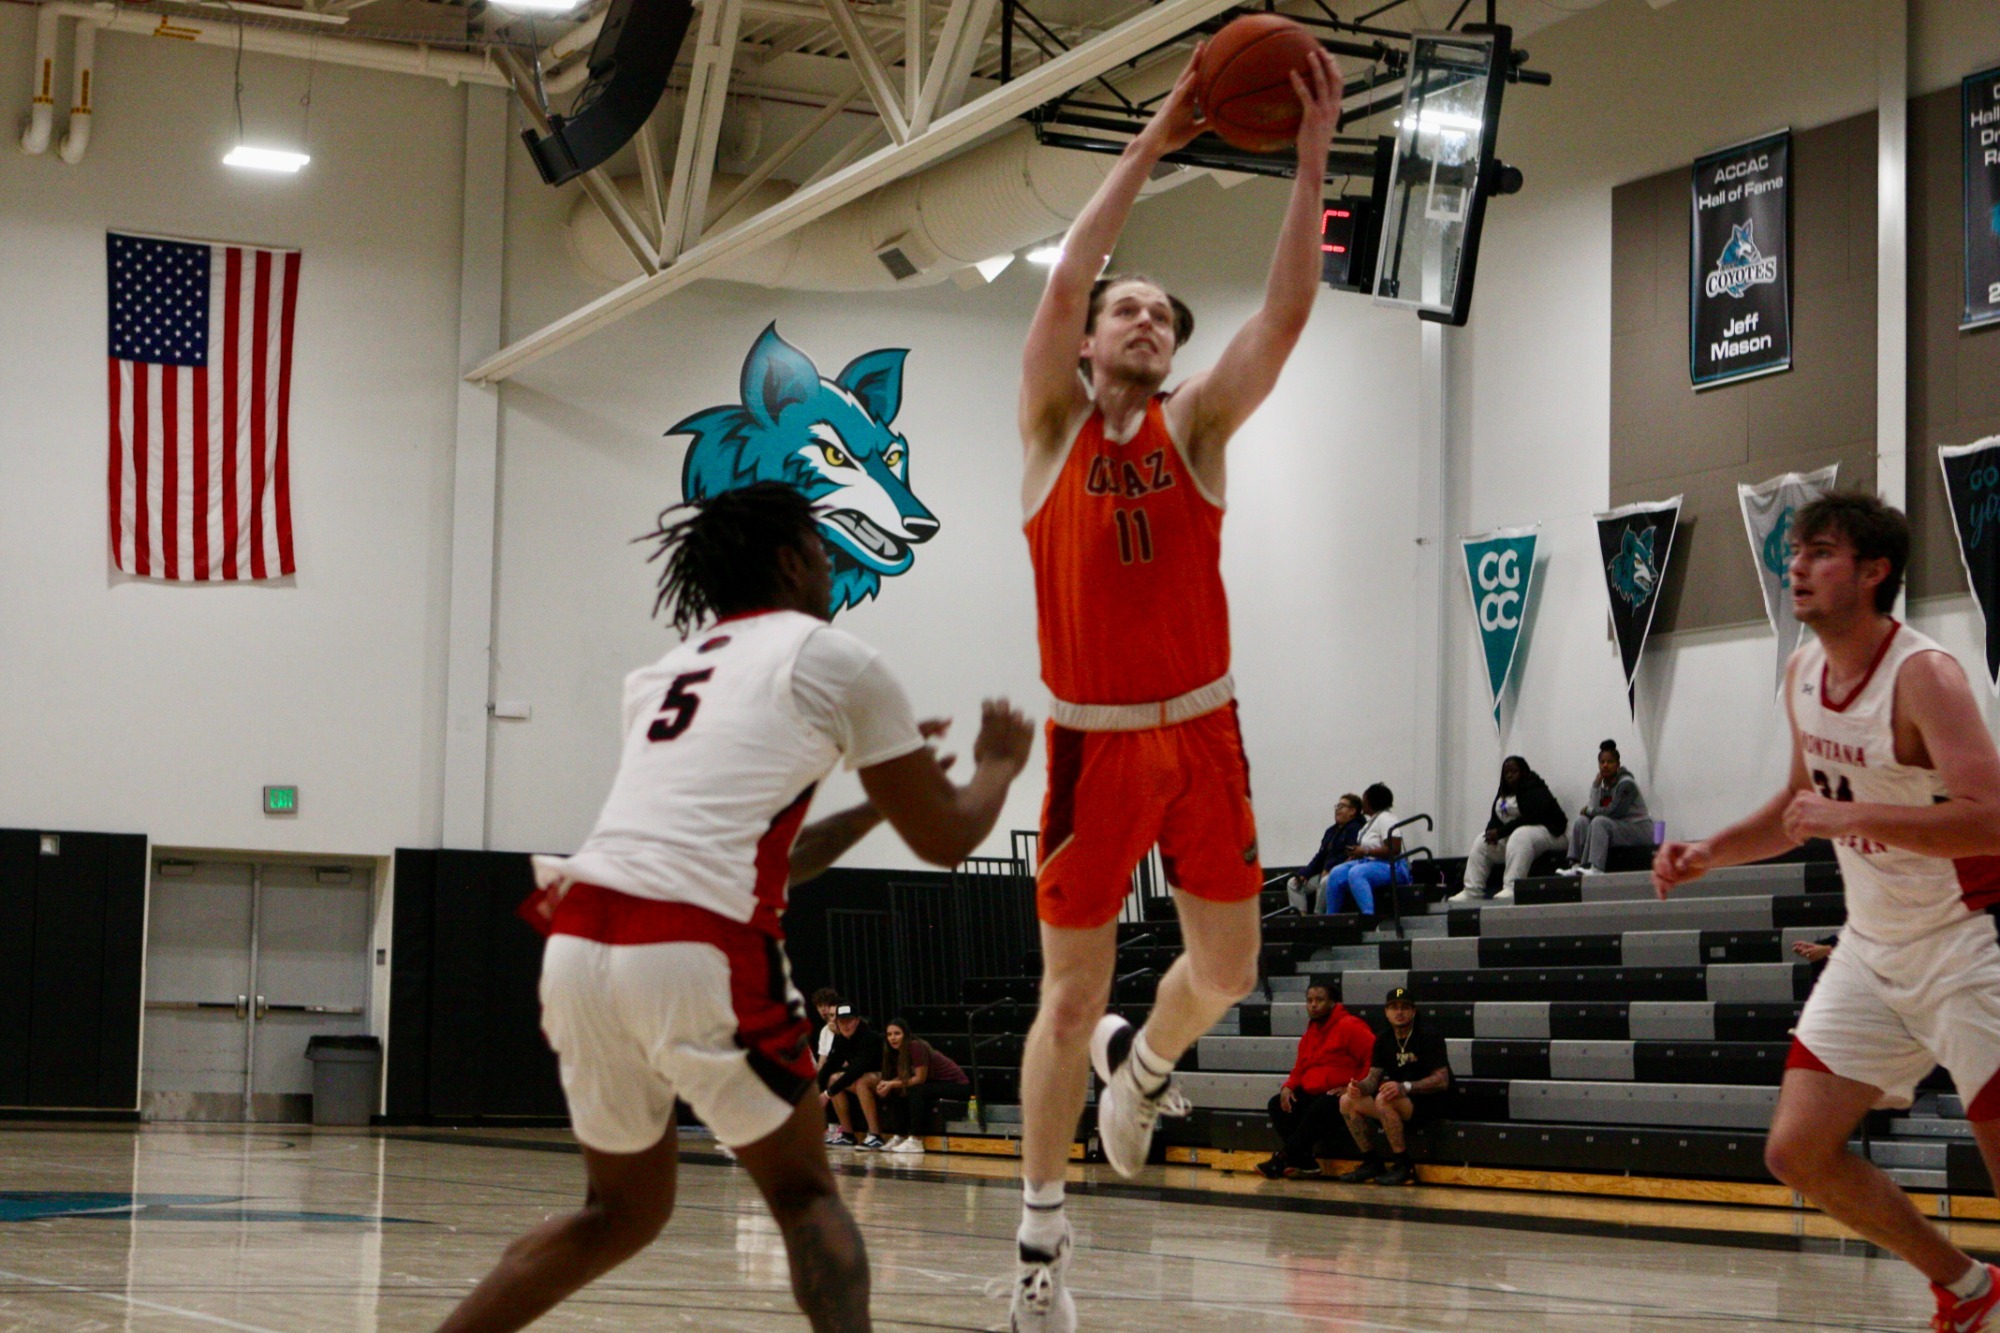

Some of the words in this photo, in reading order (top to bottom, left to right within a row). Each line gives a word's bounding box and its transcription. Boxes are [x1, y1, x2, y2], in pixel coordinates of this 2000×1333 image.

[1714, 155, 1769, 185] ACCAC
[1984, 148, 2000, 167] R
[1698, 189, 1726, 211] Hall
[1728, 184, 1743, 203] of
[1744, 176, 1784, 198] Fame
[1708, 261, 1774, 293] COYOTES
[1723, 311, 1759, 338] Jeff
[1711, 334, 1772, 362] Mason
[1115, 508, 1152, 565] 11
[646, 667, 716, 743] 5
[1396, 988, 1404, 998] P
